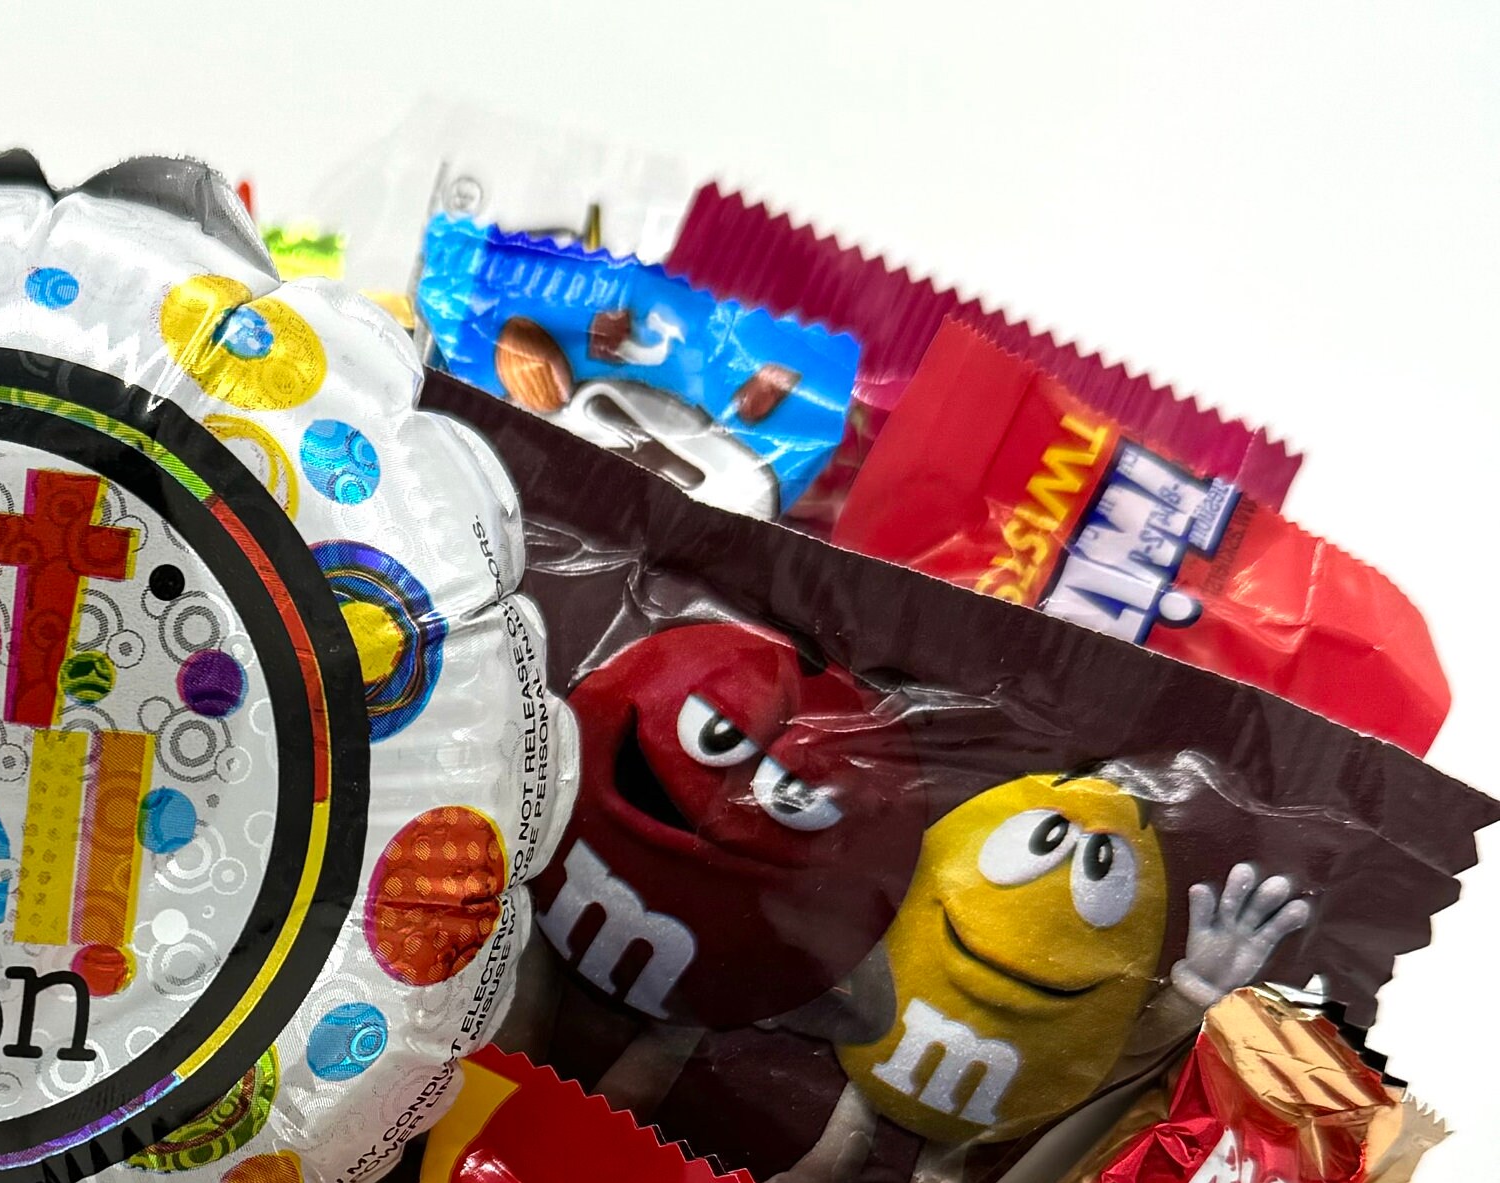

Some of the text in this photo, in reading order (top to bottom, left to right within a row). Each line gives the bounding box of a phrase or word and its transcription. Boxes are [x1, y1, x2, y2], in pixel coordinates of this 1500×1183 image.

[513, 648, 536, 773] RELEASE
[470, 943, 511, 1041] MISUSE
[533, 667, 549, 818] PERSONAL
[518, 784, 533, 841] NOT
[383, 1039, 463, 1140] CONDUT
